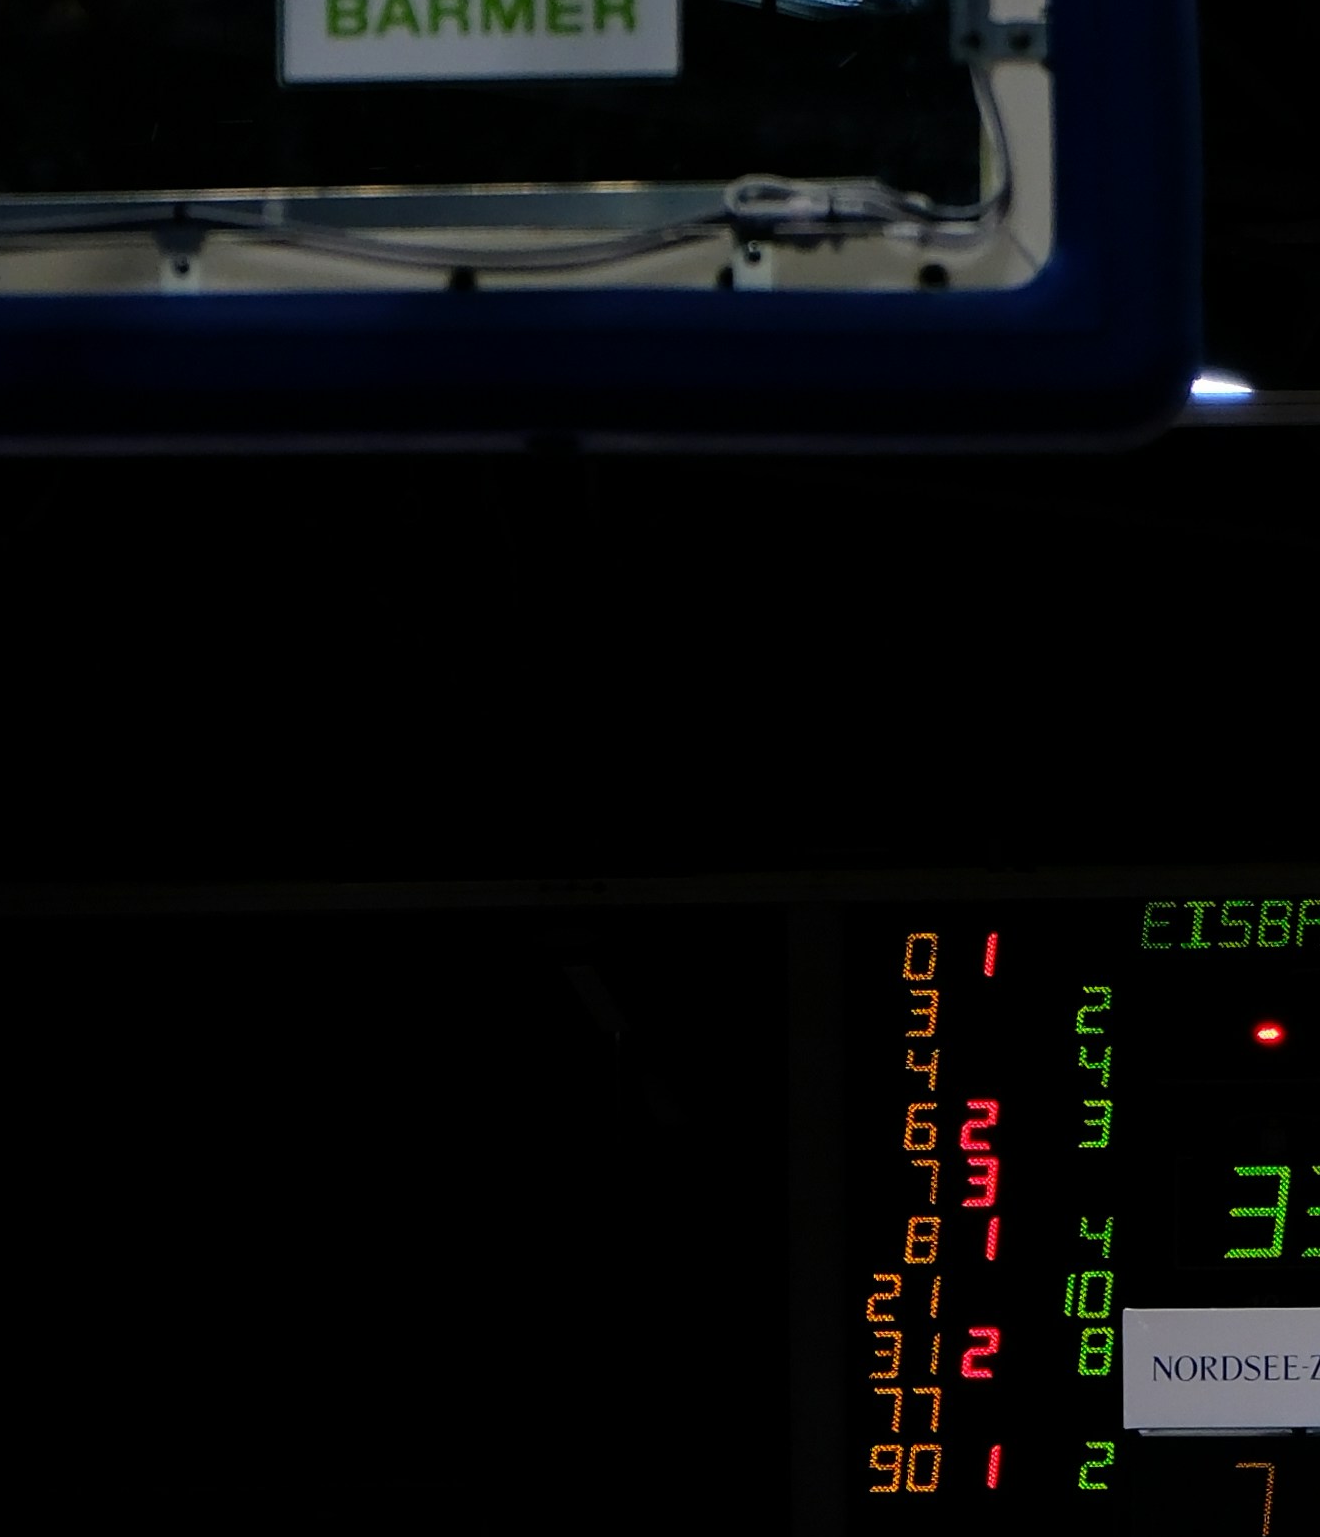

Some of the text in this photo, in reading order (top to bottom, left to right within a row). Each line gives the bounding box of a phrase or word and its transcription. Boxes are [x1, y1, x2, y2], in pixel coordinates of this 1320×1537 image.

[984, 932, 998, 977] 1
[906, 986, 1111, 1037] 3 2
[907, 1046, 1112, 1090] 4 4
[904, 1099, 1113, 1150] 6 2 3
[912, 1156, 1000, 1208] 7 3
[904, 1216, 1113, 1263] 8 1 4
[1064, 1271, 1113, 1318] 10
[960, 1326, 1001, 1379] 2
[1078, 1327, 1111, 1375] 8
[874, 1387, 942, 1432] 77
[870, 1441, 1114, 1492] 90 1 2
